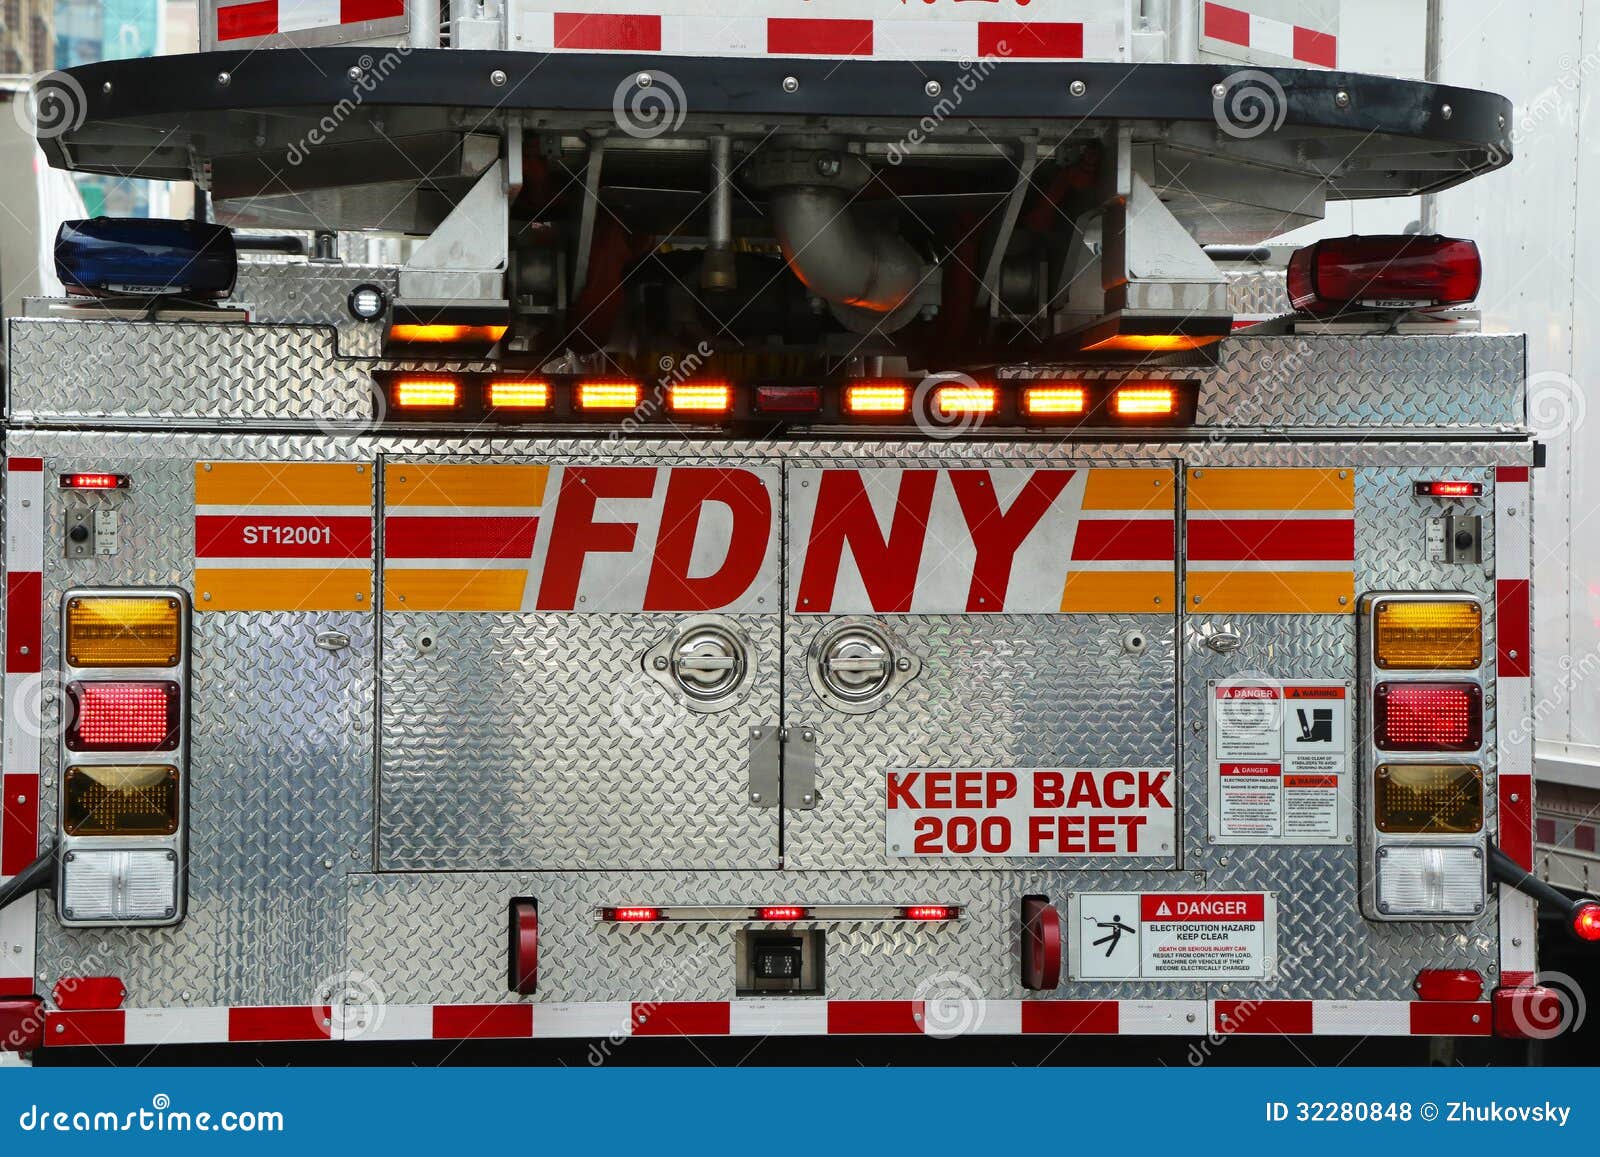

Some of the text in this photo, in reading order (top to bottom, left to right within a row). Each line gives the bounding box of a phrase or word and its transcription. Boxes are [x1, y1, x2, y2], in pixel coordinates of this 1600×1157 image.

[242, 525, 331, 545] ST12001
[535, 466, 1077, 613] FDNY
[1234, 690, 1273, 698] DANGER
[887, 771, 1173, 809] KEEP BACK
[914, 815, 1147, 853] 200 FEET
[1177, 901, 1247, 915] DANGER
[1150, 924, 1256, 932] ELECTROCUTION HAZARD
